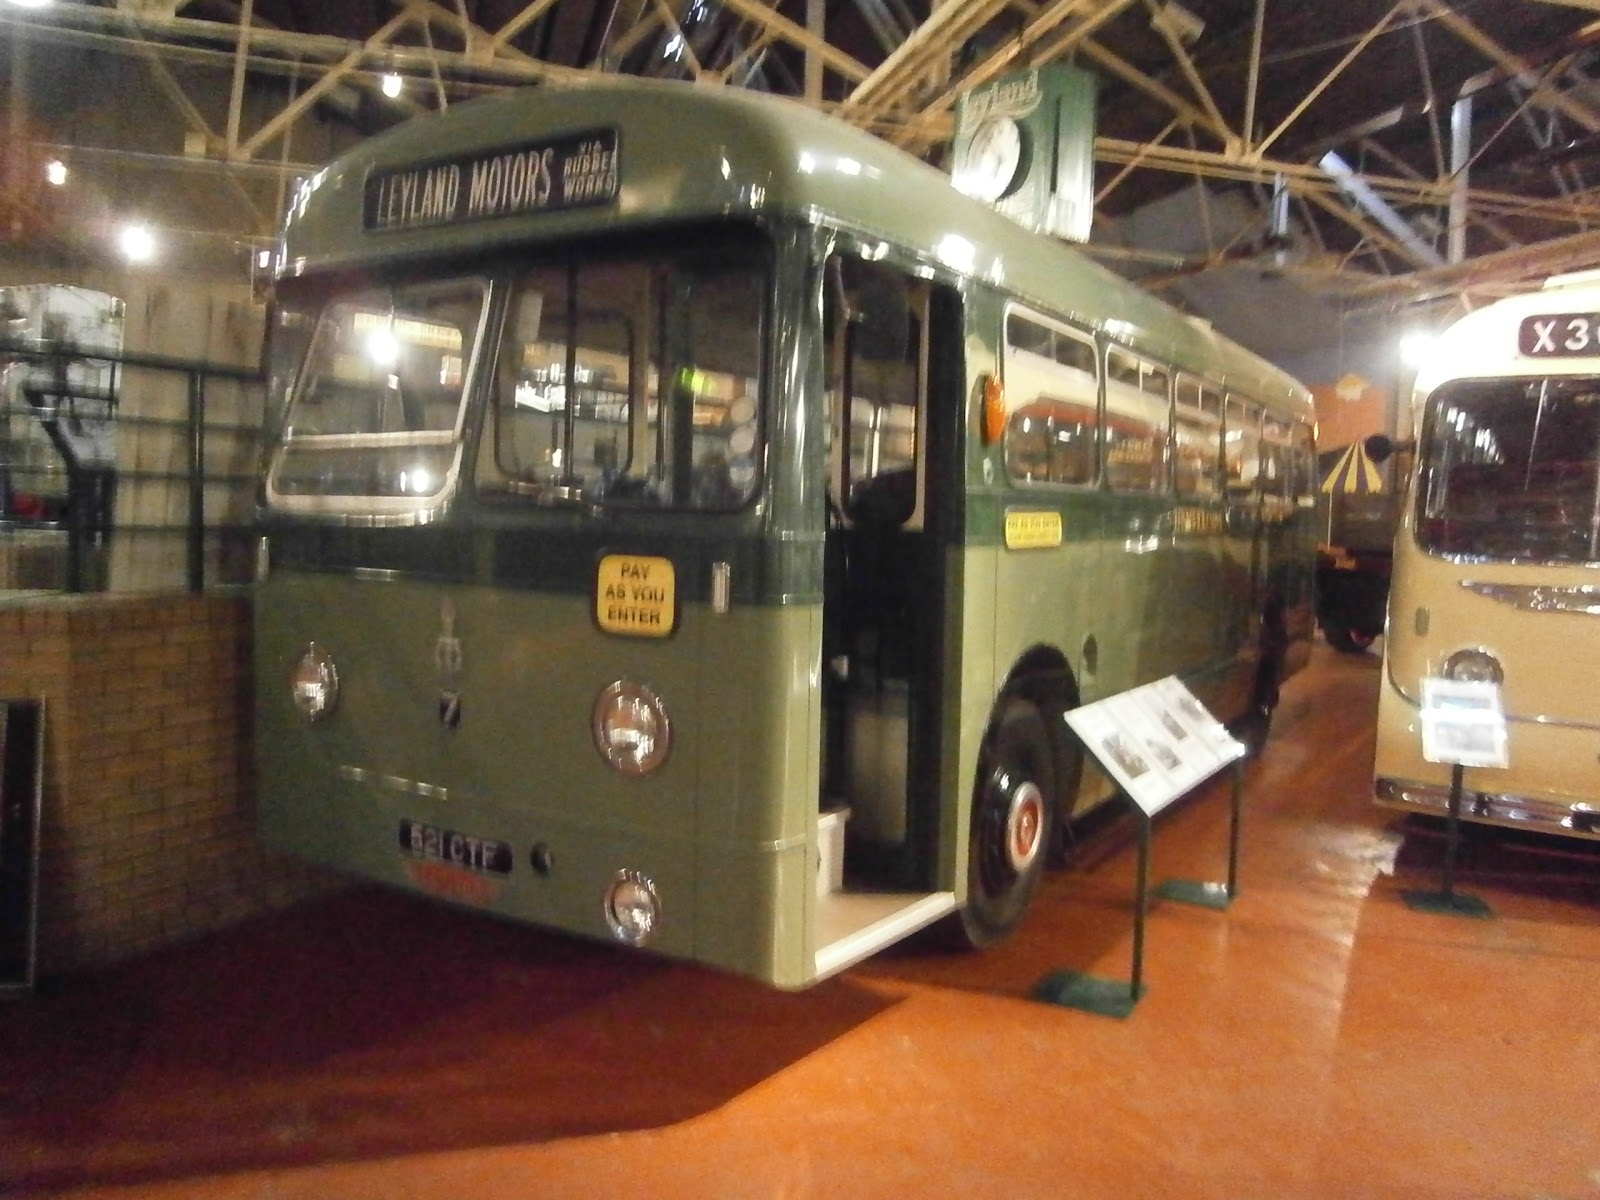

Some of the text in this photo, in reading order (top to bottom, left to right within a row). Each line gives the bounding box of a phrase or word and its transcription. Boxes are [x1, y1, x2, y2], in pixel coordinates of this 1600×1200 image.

[377, 147, 554, 225] LEYLAND MOTORS
[621, 562, 651, 580] PAY
[605, 583, 665, 603] AS YOU
[607, 605, 661, 624] ENTER
